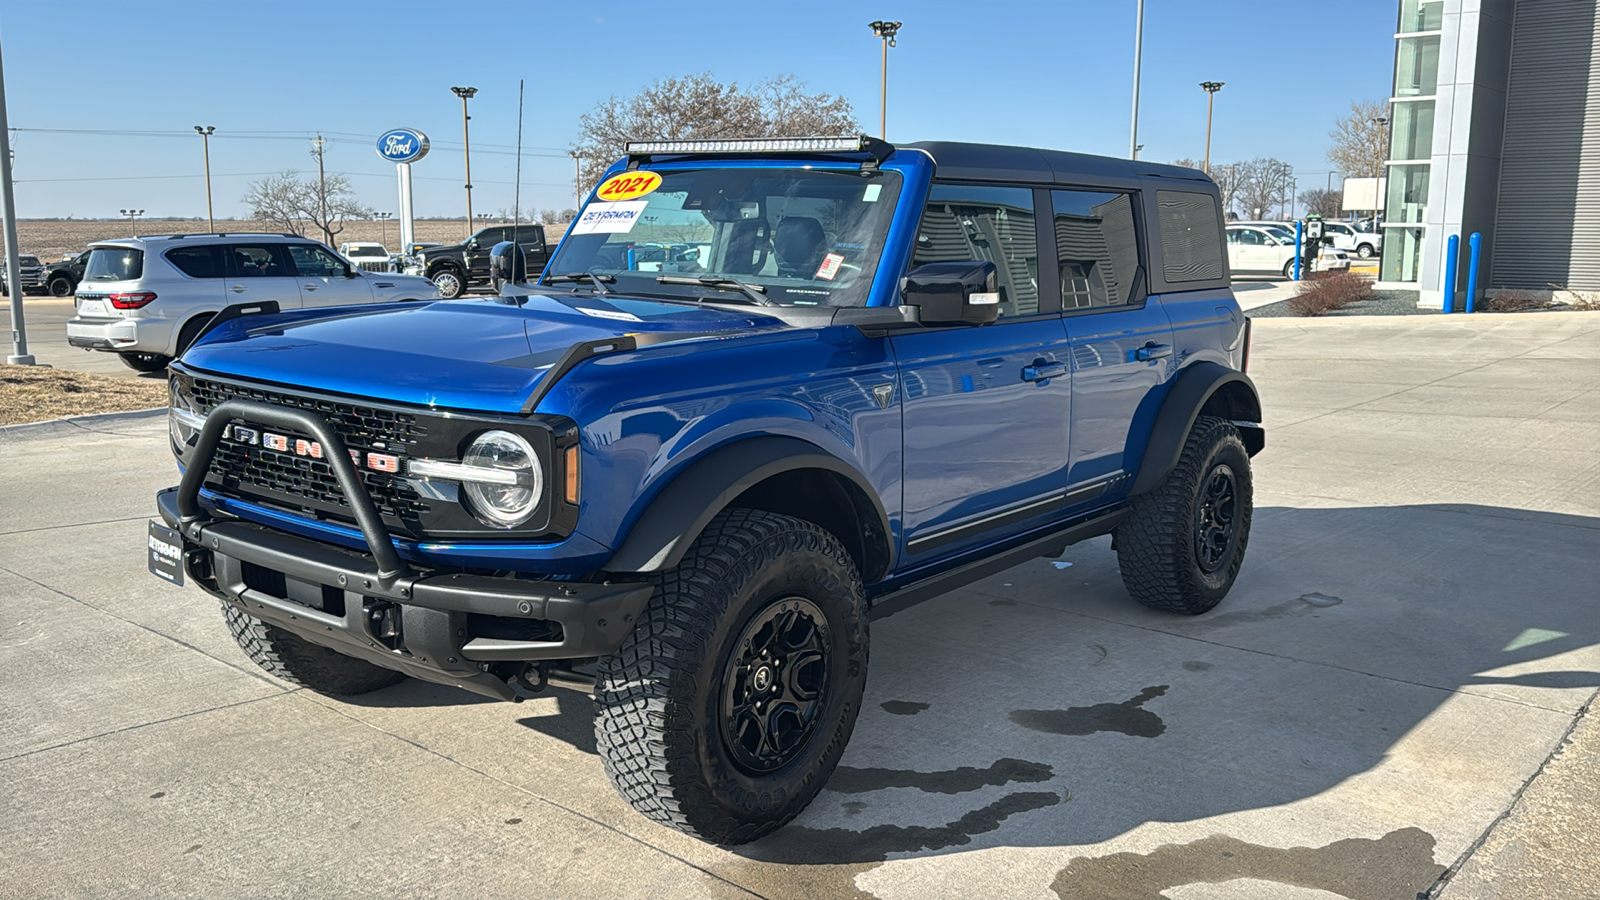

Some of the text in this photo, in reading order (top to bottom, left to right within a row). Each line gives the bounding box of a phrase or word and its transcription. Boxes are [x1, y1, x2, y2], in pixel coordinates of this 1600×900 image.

[384, 134, 412, 155] Ford
[601, 176, 656, 195] 2021
[583, 210, 638, 221] DEYARMAN
